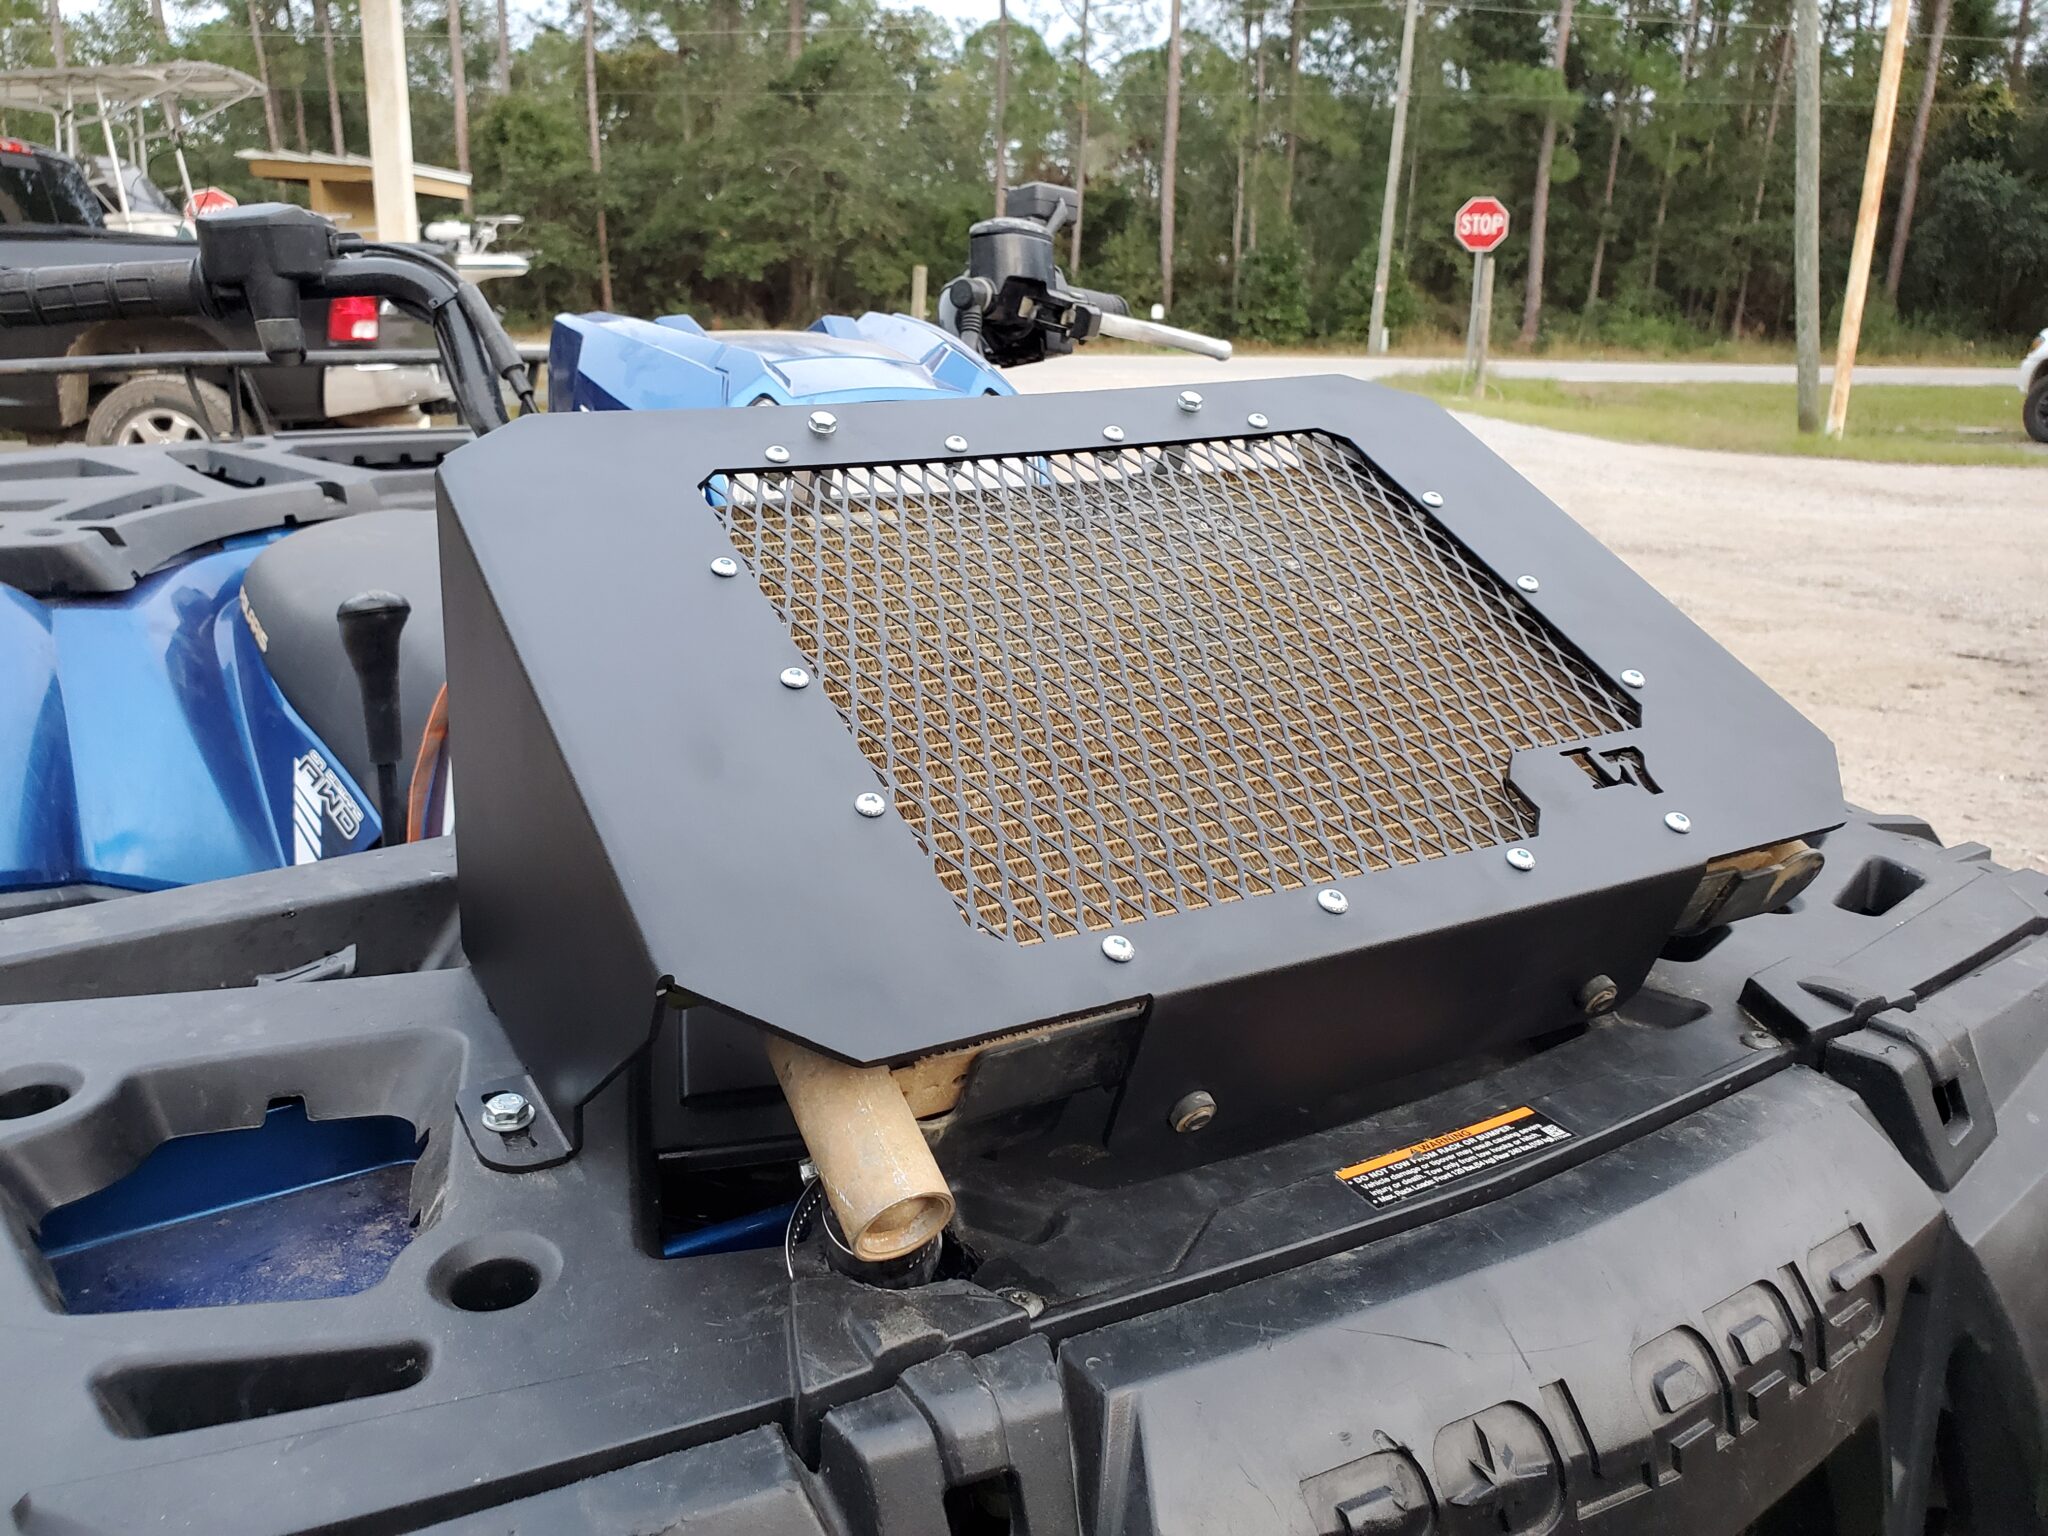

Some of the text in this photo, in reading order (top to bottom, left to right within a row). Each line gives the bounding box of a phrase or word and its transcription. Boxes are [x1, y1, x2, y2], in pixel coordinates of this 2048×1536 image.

[1460, 212, 1504, 236] STOP
[298, 756, 359, 838] AWD
[1352, 1174, 1369, 1183] DO
[1367, 1167, 1388, 1178] NOT
[1387, 1159, 1410, 1171] TOW
[1436, 1141, 1464, 1154] RACK
[1461, 1137, 1477, 1145] OR
[1475, 1124, 1515, 1140] BUMPER.
[1360, 1177, 1391, 1189] Vehicle
[1389, 1166, 1421, 1180] damage
[1455, 1148, 1473, 1157] may
[1491, 1131, 1521, 1144] causing
[1518, 1123, 1544, 1134] severe
[1418, 1130, 1471, 1150] WARNING
[1423, 1167, 1443, 1175] Tow
[1442, 1161, 1460, 1170] only
[1457, 1155, 1478, 1164] from
[1488, 1142, 1514, 1153] hooks
[1299, 1222, 1886, 1536] POLARIS
